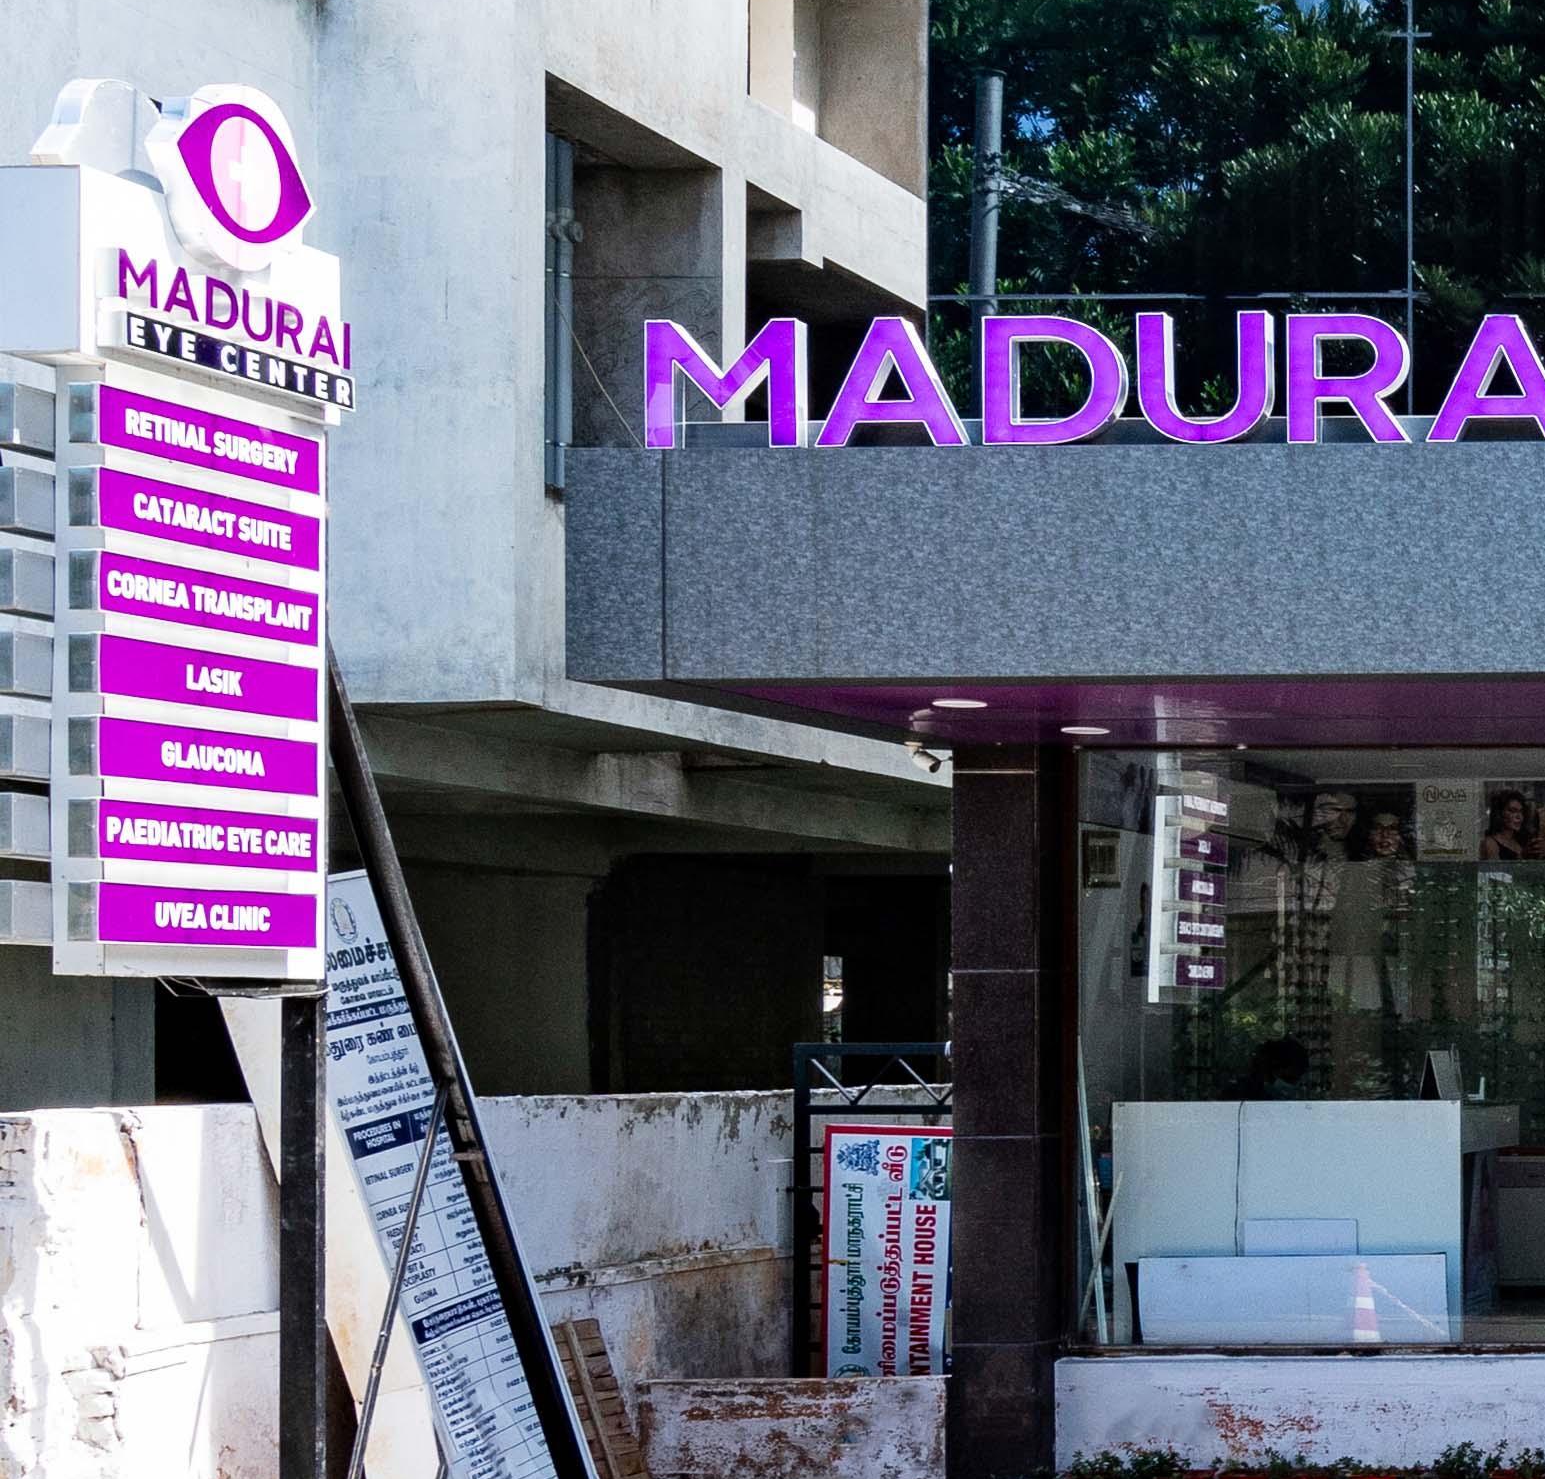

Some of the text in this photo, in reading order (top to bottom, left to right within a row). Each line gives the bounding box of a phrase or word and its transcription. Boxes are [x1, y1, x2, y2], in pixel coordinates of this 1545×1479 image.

[118, 248, 351, 370] MADURAI
[130, 317, 350, 406] EYE CENTER
[125, 408, 298, 475] RETINAL SURGERY
[133, 493, 292, 551] CATARACT SUITE
[107, 570, 313, 632] CORNEA TRANSPLANT
[186, 664, 243, 696] LASIK
[161, 741, 265, 776] GLAUCOMA
[106, 817, 311, 857] PAEDIATRIC EYE CARE
[155, 902, 271, 932] UVEA CLINIC
[913, 1204, 937, 1265] HOUSE
